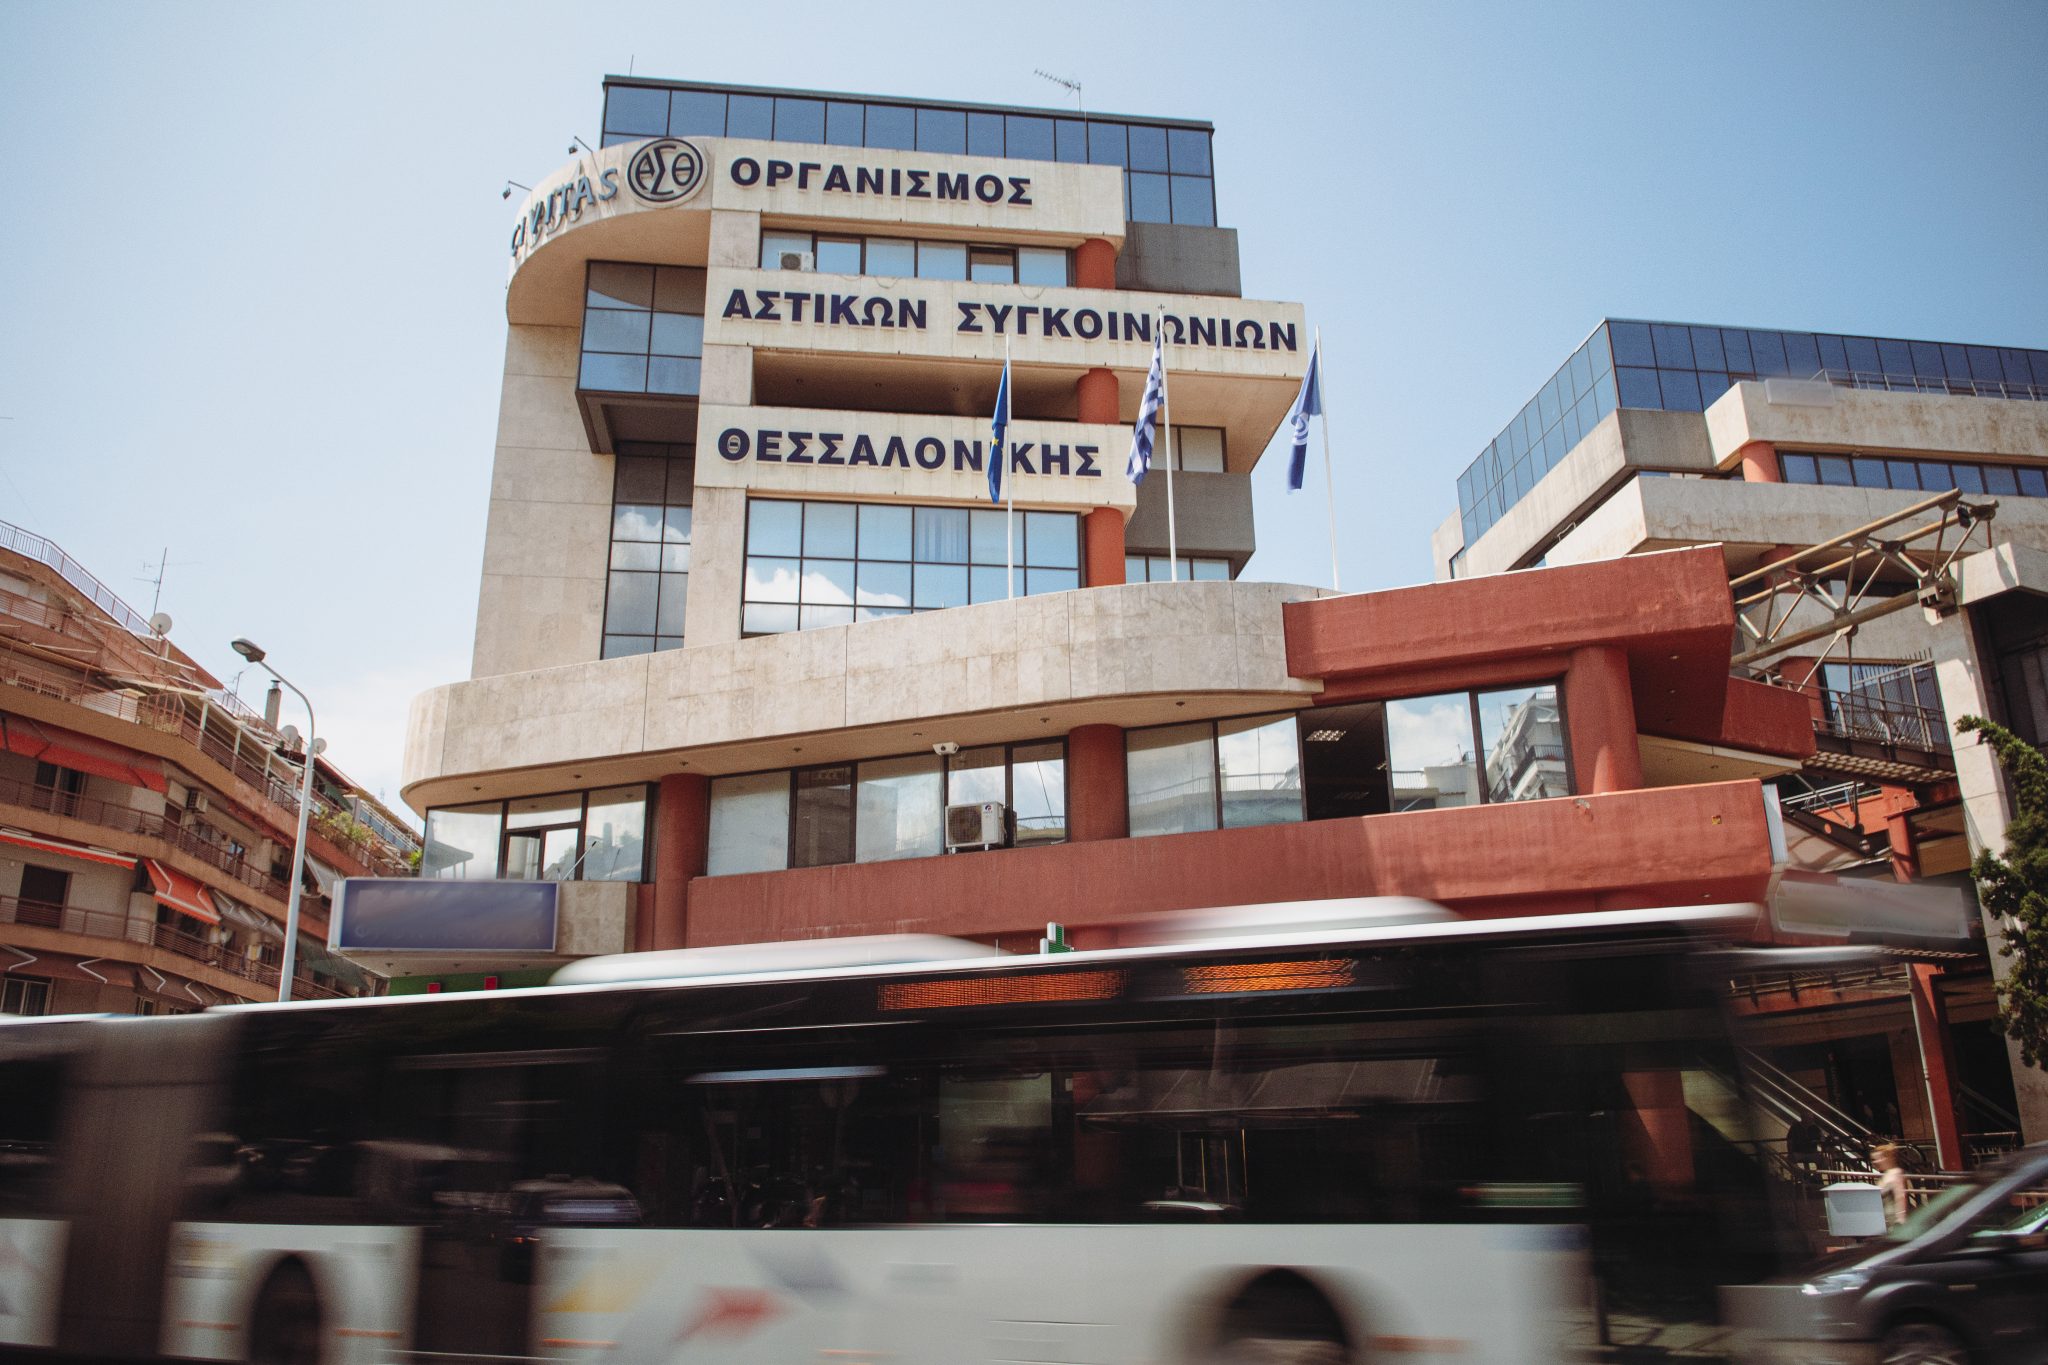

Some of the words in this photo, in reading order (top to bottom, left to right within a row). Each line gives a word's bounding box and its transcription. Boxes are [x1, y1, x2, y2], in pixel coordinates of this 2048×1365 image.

[730, 157, 1033, 206] ΟΡΓΑΝΙΣΜΟΣ
[511, 167, 619, 257] CIVITAS
[722, 288, 927, 331] ΑΣΤΙΚΩΝ
[957, 301, 1297, 352] ΣΥΓΚΟΙΝΩΝΙΩΝ
[718, 427, 1102, 477] ΘΕΣΣΑΛΟΝΚΗΣ
